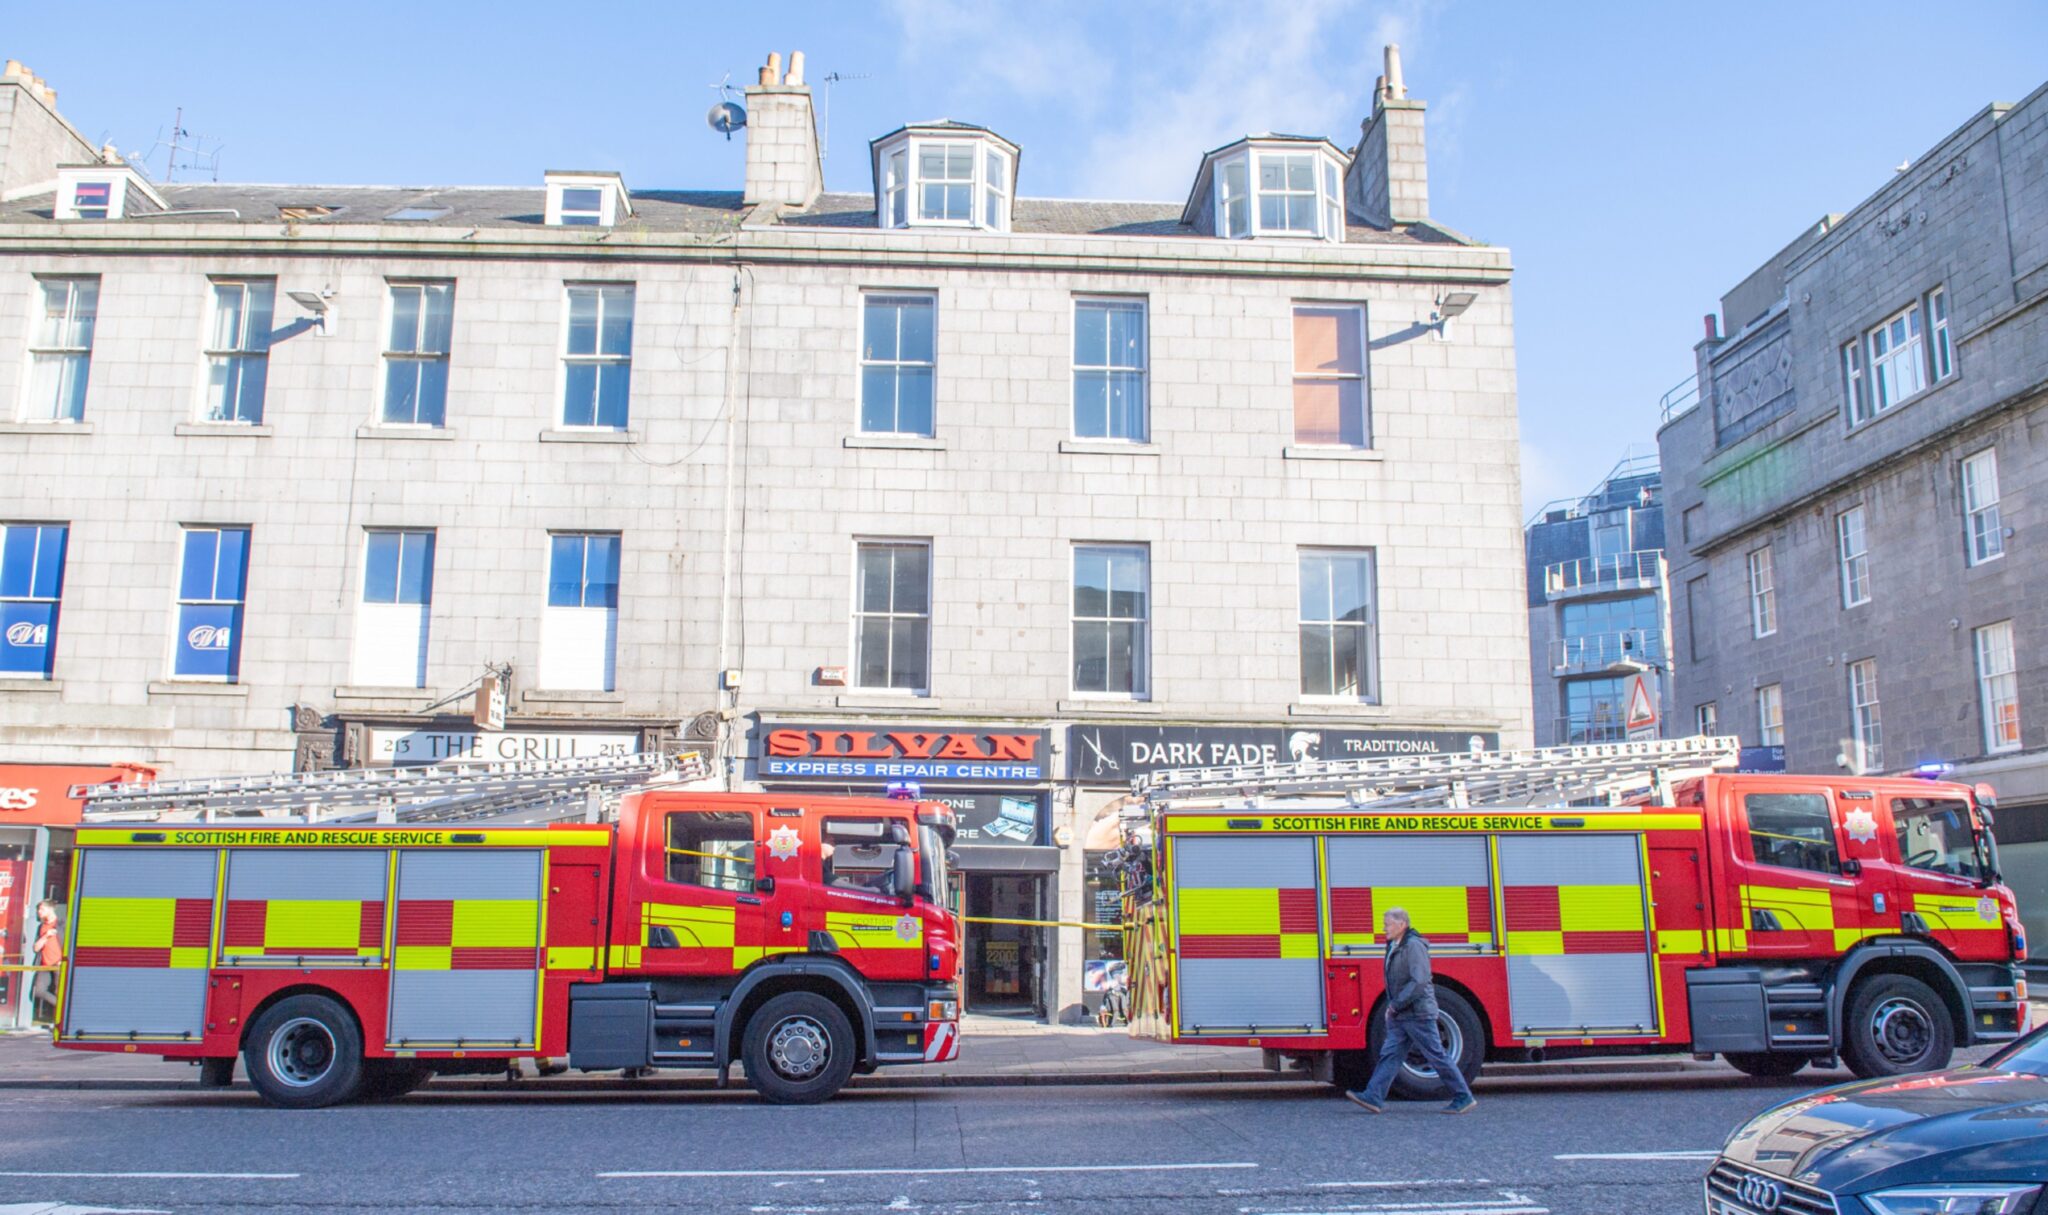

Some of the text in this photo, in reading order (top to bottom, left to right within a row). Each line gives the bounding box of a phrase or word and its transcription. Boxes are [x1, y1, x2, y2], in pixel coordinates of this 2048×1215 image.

[384, 740, 410, 753] 213
[426, 735, 483, 758] THE
[600, 744, 626, 758] 213
[769, 729, 1041, 760] SILVAN
[1131, 742, 1277, 765] DARK FADE
[1343, 739, 1440, 753] TRADITIONAL
[770, 763, 1039, 778] EXPRESS REPAIR CENTRE
[0, 787, 39, 810] es
[1272, 817, 1542, 829] SCOTTISH FIRE AND RESCUE SERVICE
[175, 831, 443, 844] SCOTTISH FIRE AND RESCUE SERVICE
